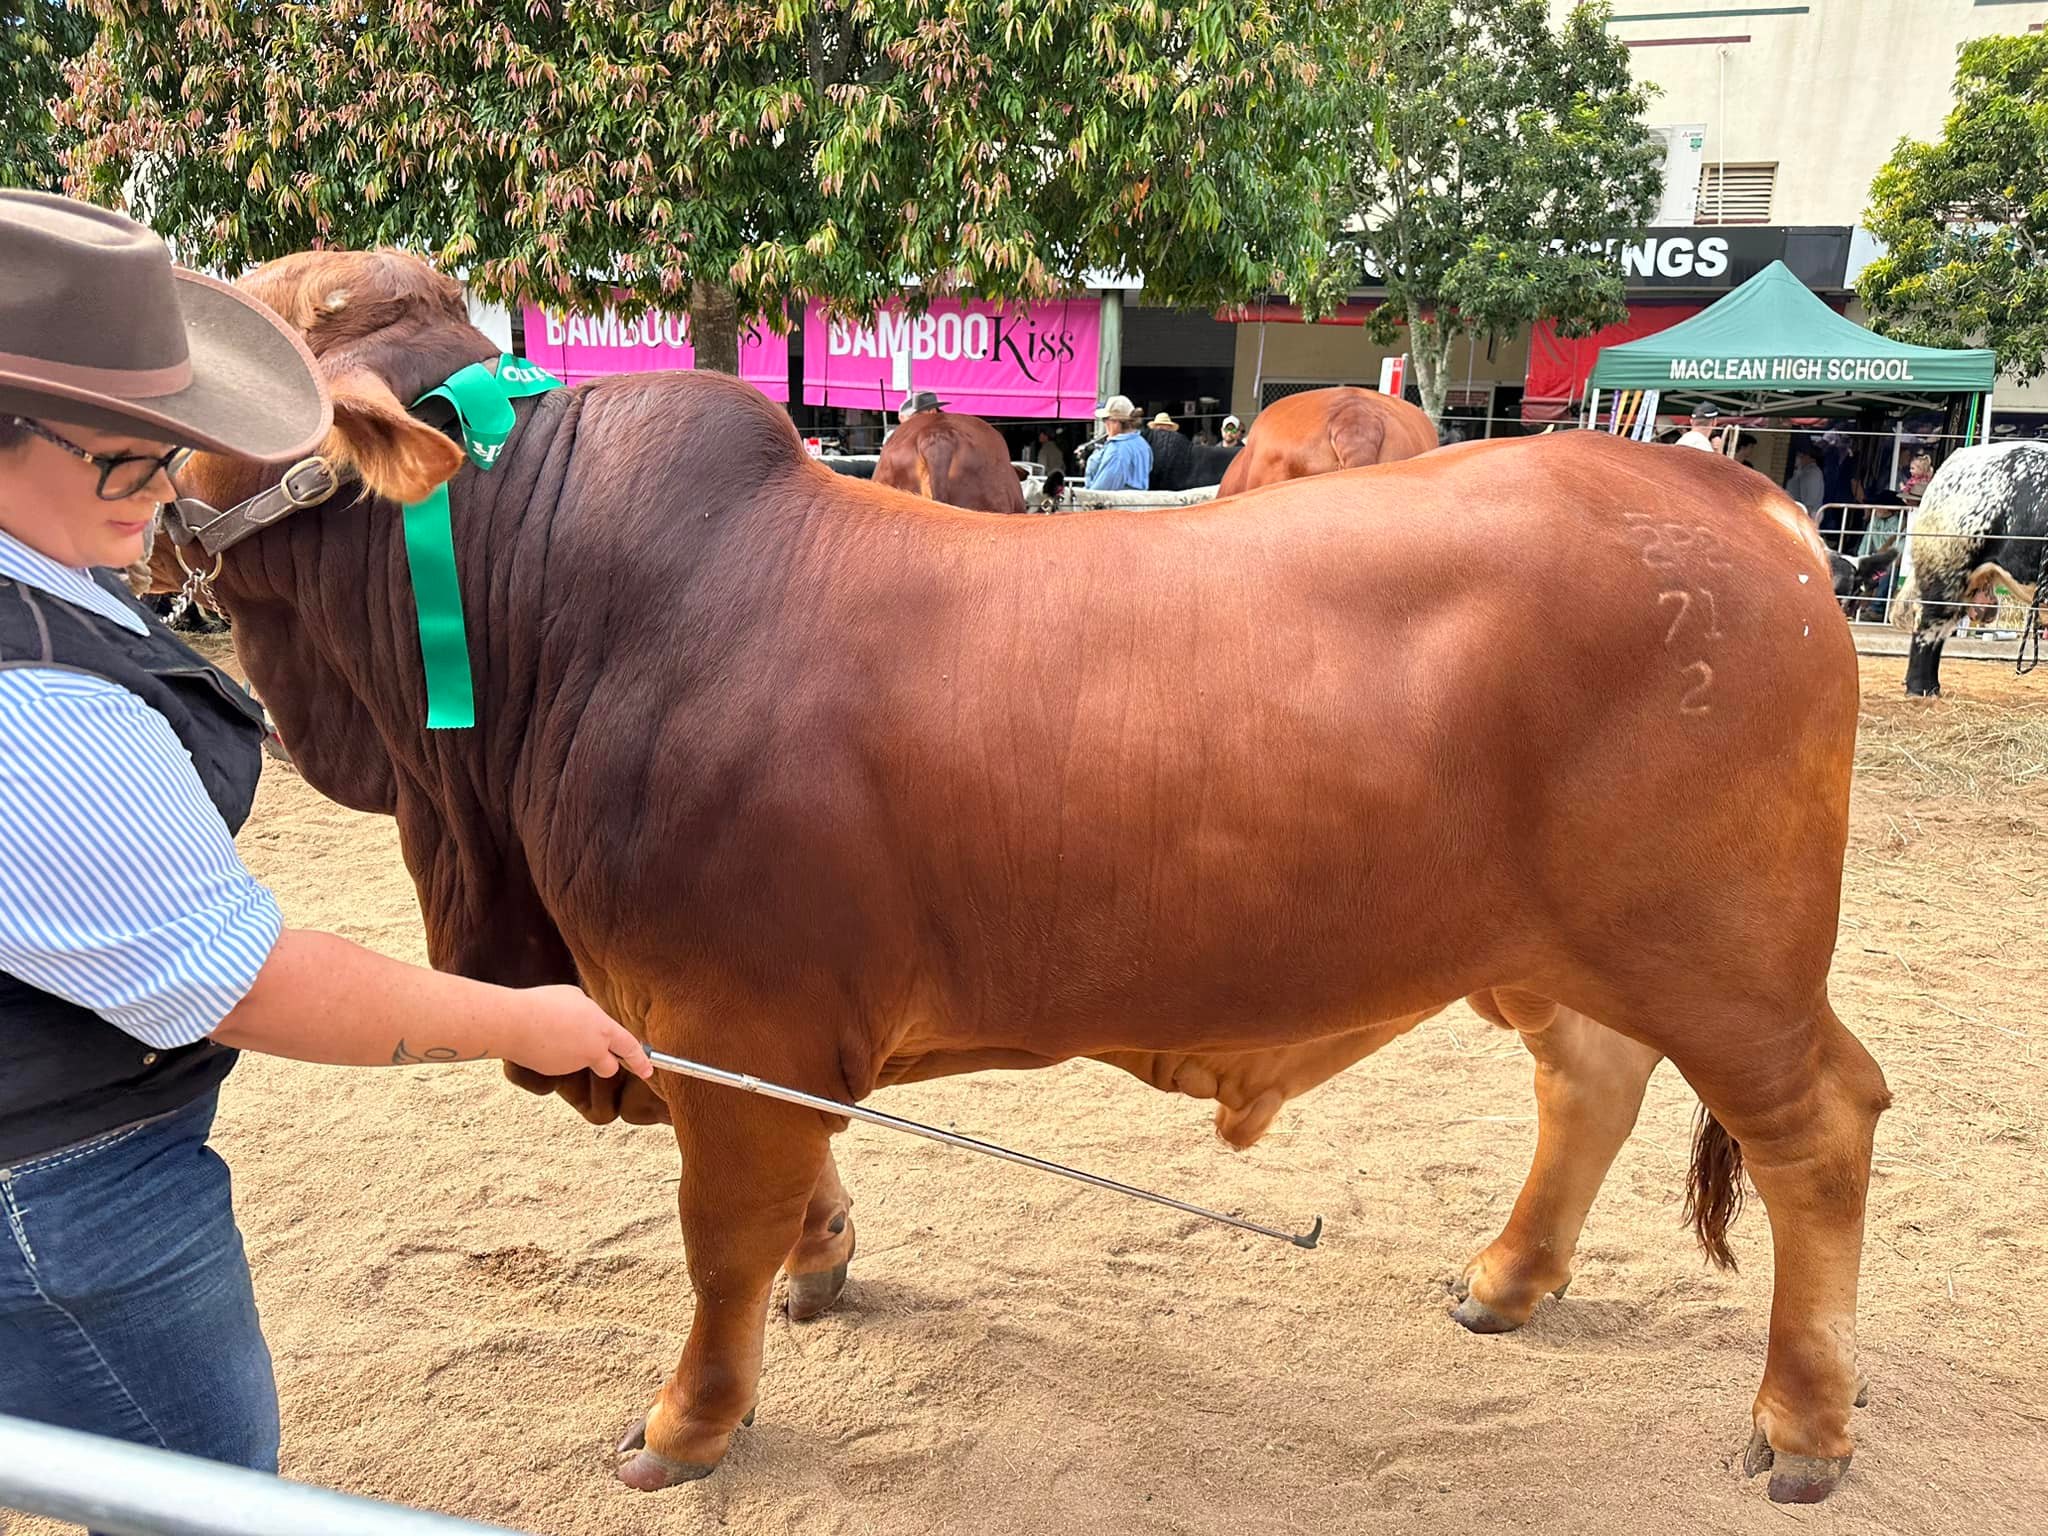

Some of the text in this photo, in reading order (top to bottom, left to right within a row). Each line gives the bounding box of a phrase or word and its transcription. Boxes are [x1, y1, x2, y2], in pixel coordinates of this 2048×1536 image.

[546, 301, 687, 348] BAMBOO
[828, 310, 988, 361] BAMBOO
[983, 314, 1075, 383] Kiss
[1669, 358, 1914, 381] MACLEAN HIGH SCHOOL
